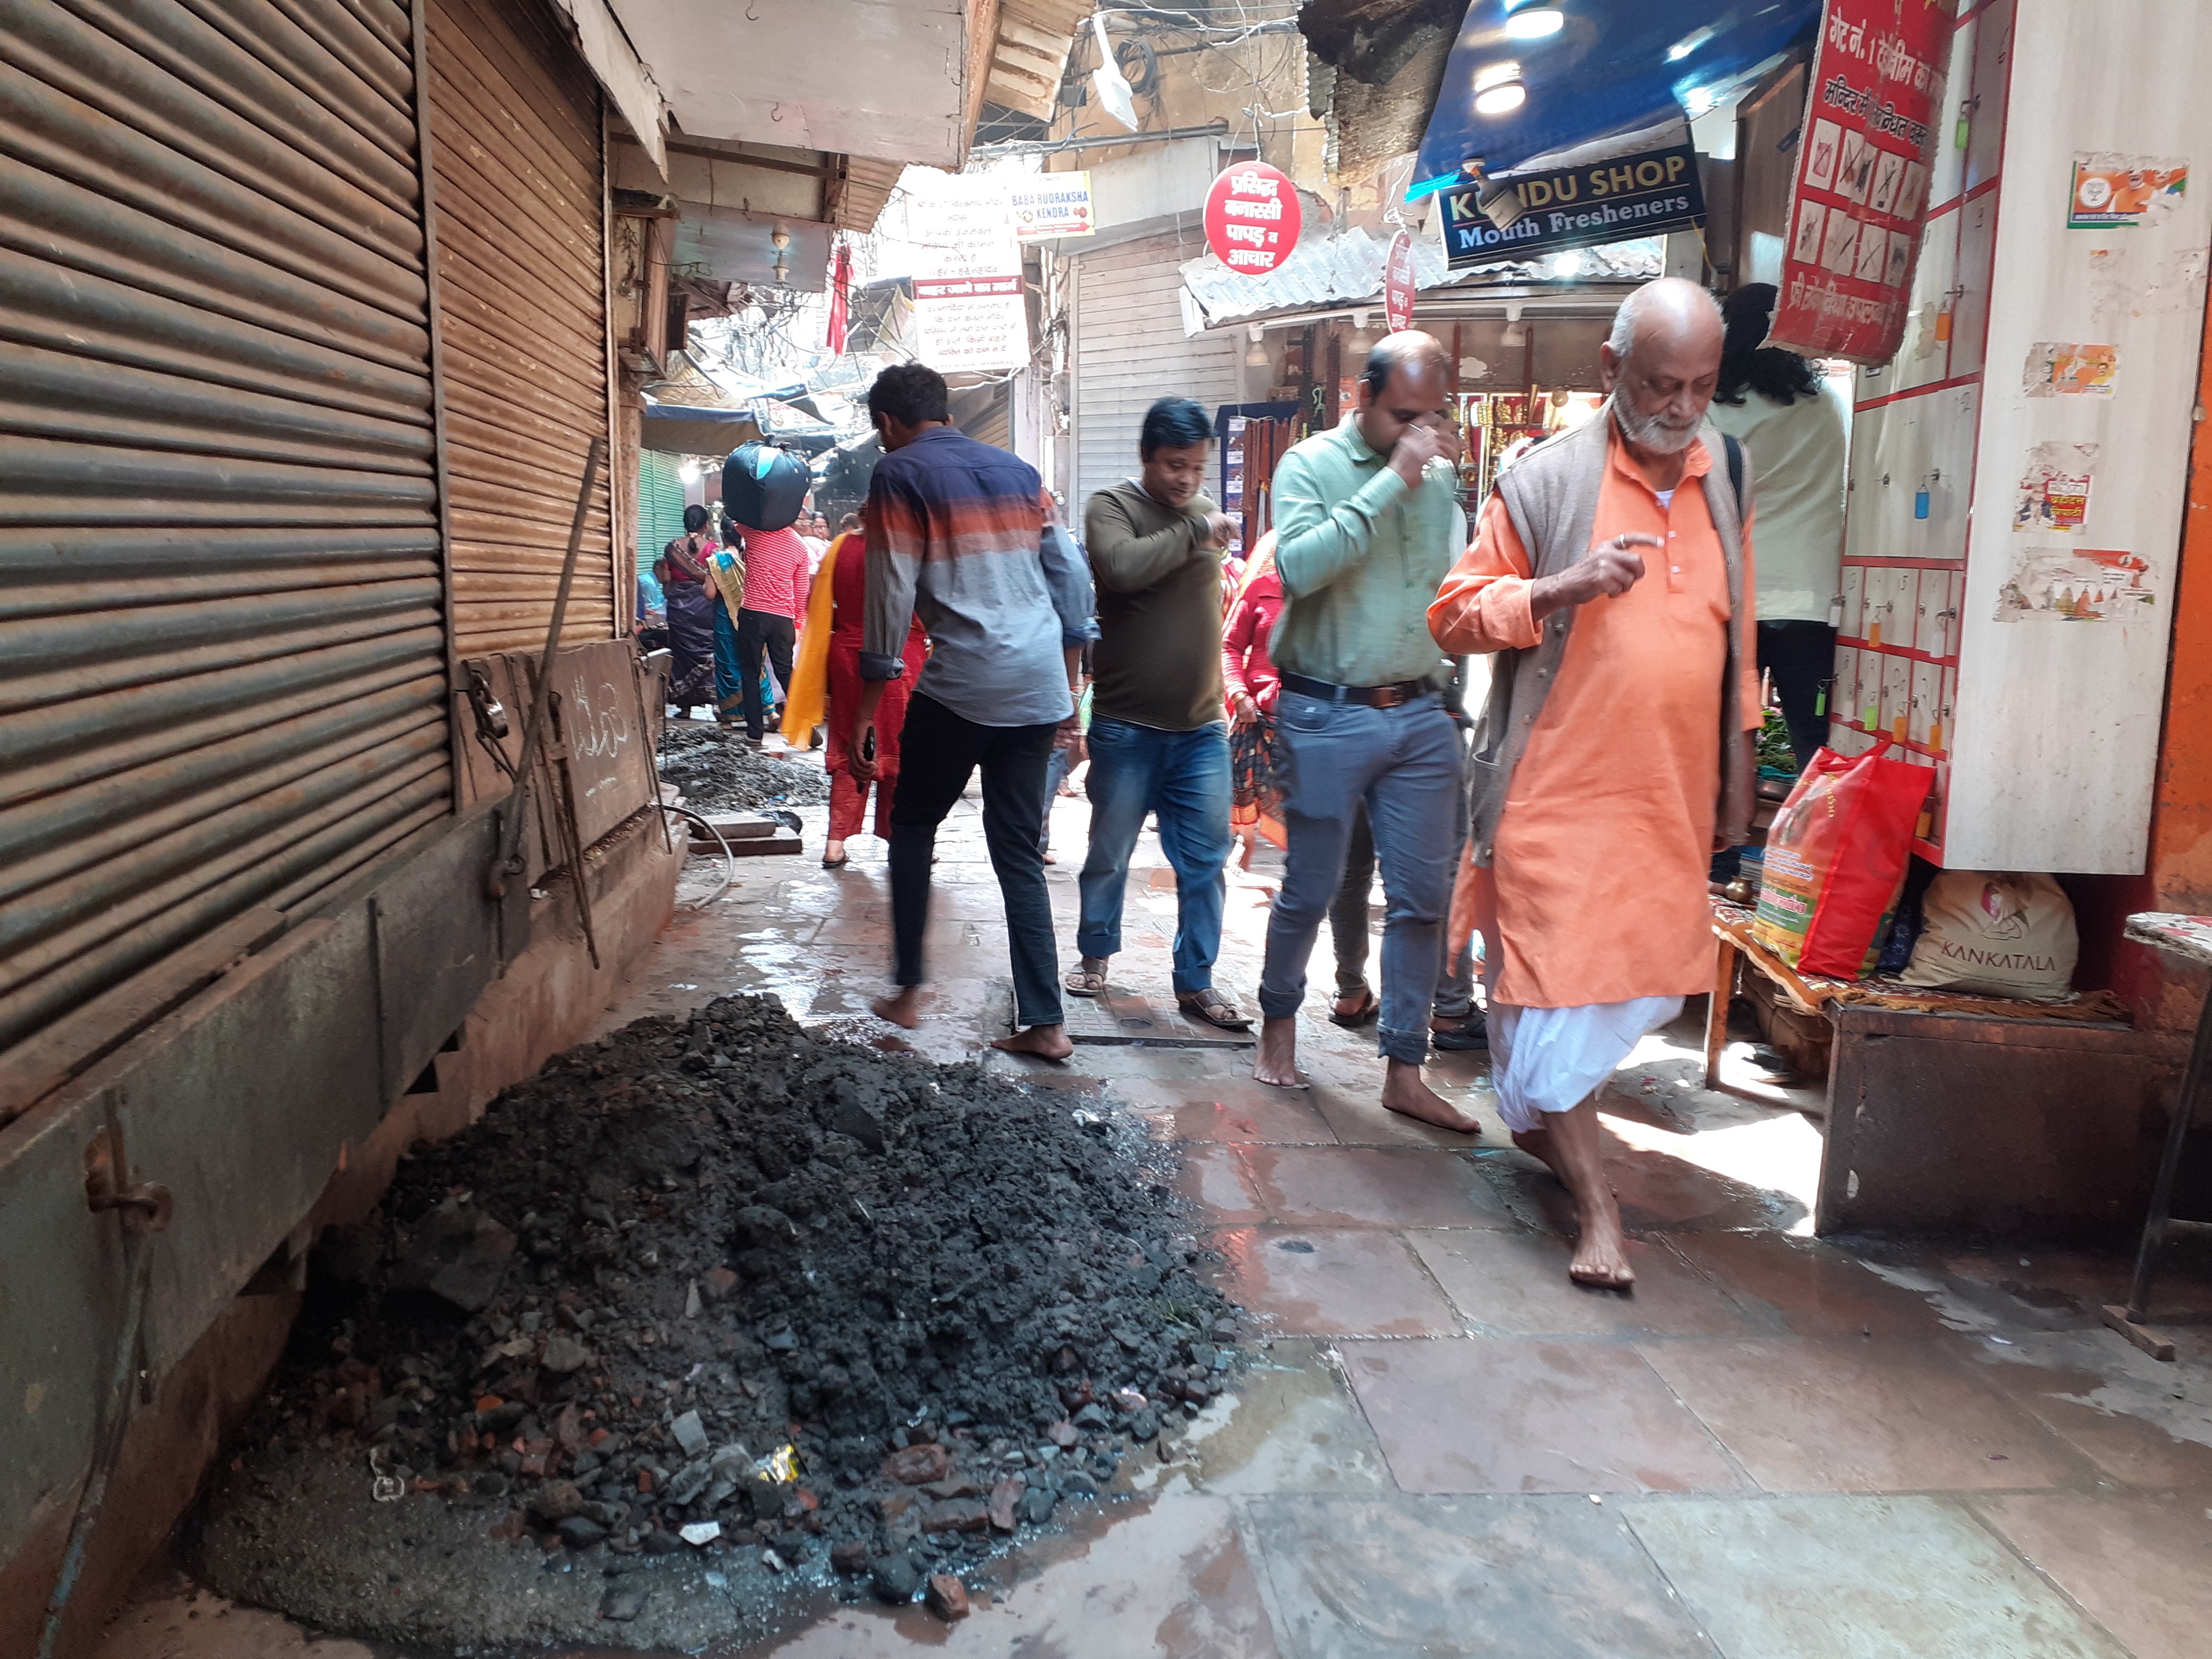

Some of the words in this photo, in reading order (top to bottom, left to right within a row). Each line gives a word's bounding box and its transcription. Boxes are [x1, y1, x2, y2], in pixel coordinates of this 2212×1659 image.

[1829, 6, 1850, 53] गेट
[1824, 74, 1860, 115] मन्दिर
[1231, 170, 1279, 197] प्रसिद्ध
[1589, 155, 1686, 196] SHOP
[1012, 194, 1035, 206] BABA
[1037, 191, 1088, 204] RUDRAKSHA
[1037, 206, 1070, 219] KENDRA
[1459, 217, 1541, 249] Mouth
[1550, 195, 1690, 233] Fresheners
[1225, 224, 1266, 248] पापड़
[1268, 231, 1279, 243] व
[1227, 249, 1276, 267] आचार
[947, 281, 973, 294] जाने
[974, 283, 991, 293] का
[992, 278, 1018, 292] मार्ग
[1942, 941, 2056, 971] KANKATALA
